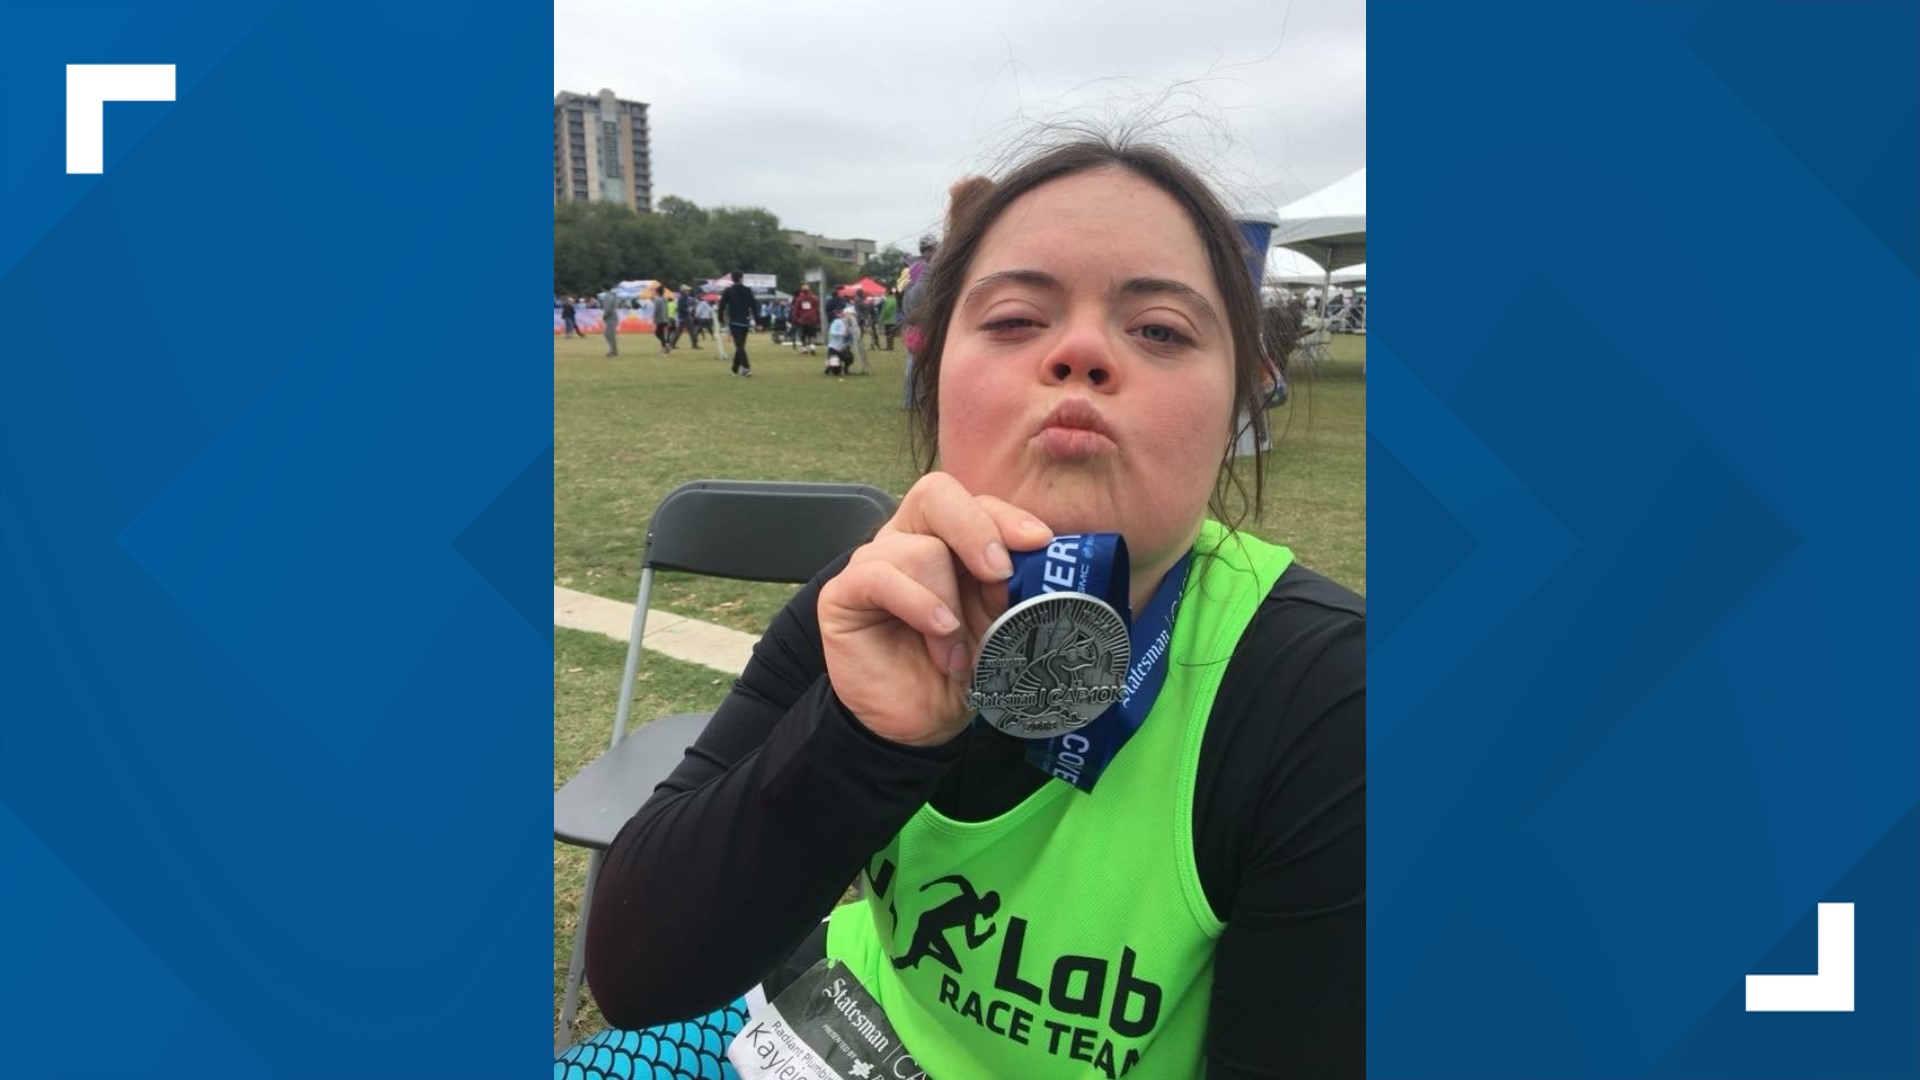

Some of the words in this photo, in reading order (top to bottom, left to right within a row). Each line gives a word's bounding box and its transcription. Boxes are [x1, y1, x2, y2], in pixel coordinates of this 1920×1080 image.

[939, 973, 1034, 1046] RACE
[994, 915, 1162, 1038] Lab
[772, 1020, 804, 1058] Radiant
[821, 977, 889, 1053] Statesman
[822, 1023, 851, 1053] PRESENTED
